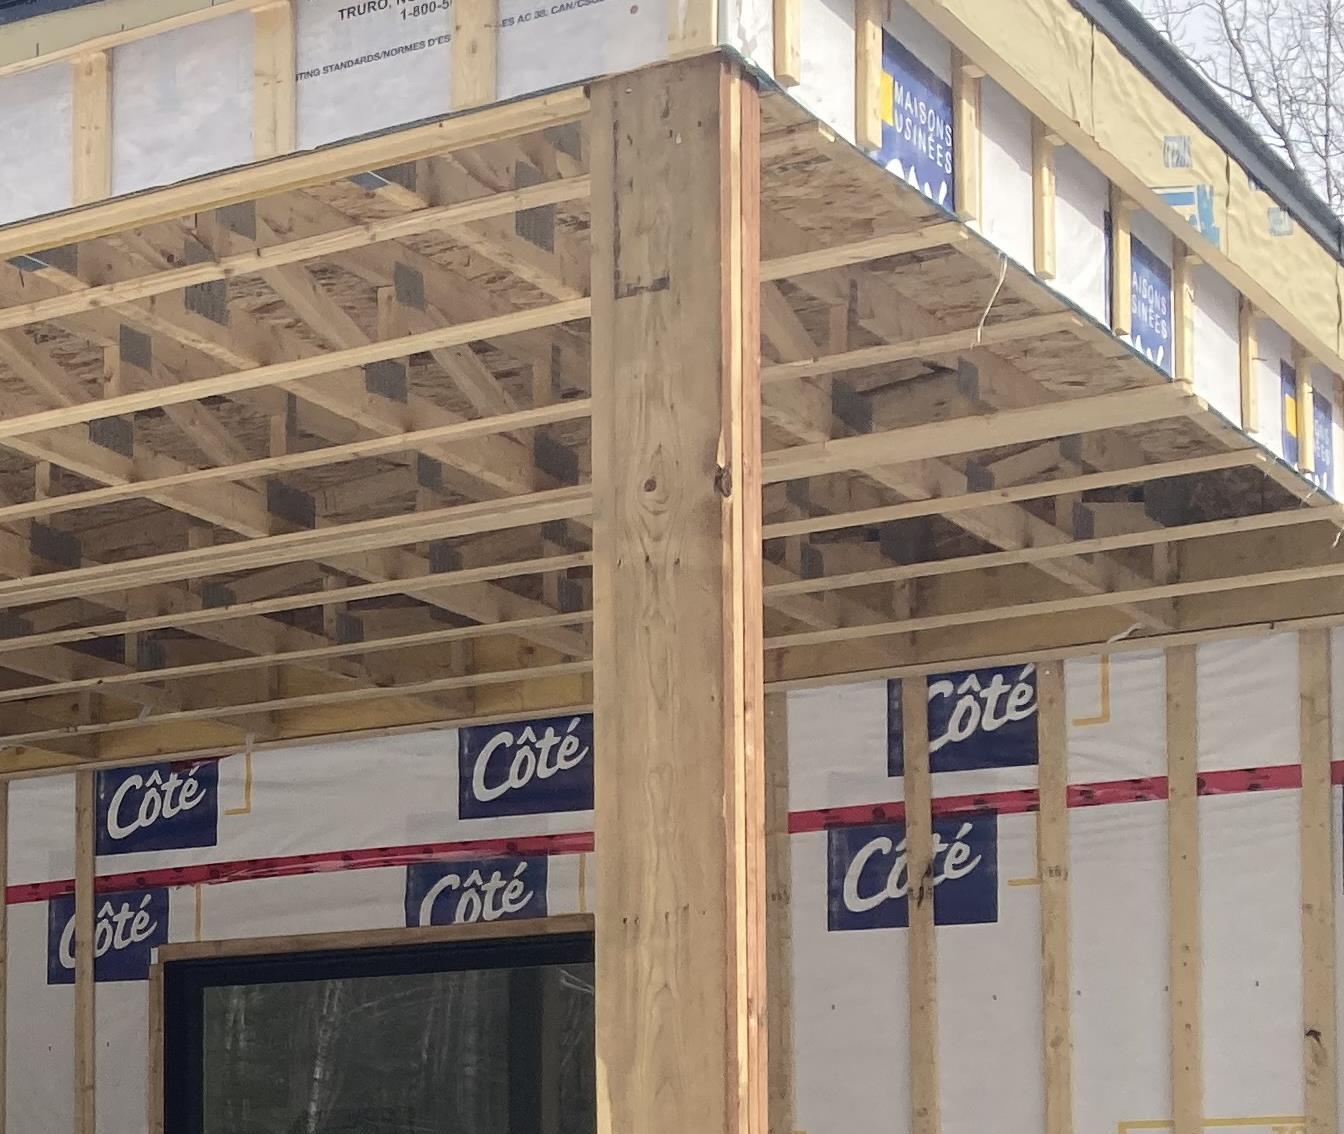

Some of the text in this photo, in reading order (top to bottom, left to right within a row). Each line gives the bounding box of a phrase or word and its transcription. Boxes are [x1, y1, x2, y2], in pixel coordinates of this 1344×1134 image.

[894, 80, 953, 148] MAISONS
[894, 108, 953, 175] USINÉES
[1131, 270, 1167, 316] AISONS
[1131, 298, 1169, 340] SINÉES
[471, 716, 590, 803] Côté
[104, 764, 207, 841] Côté
